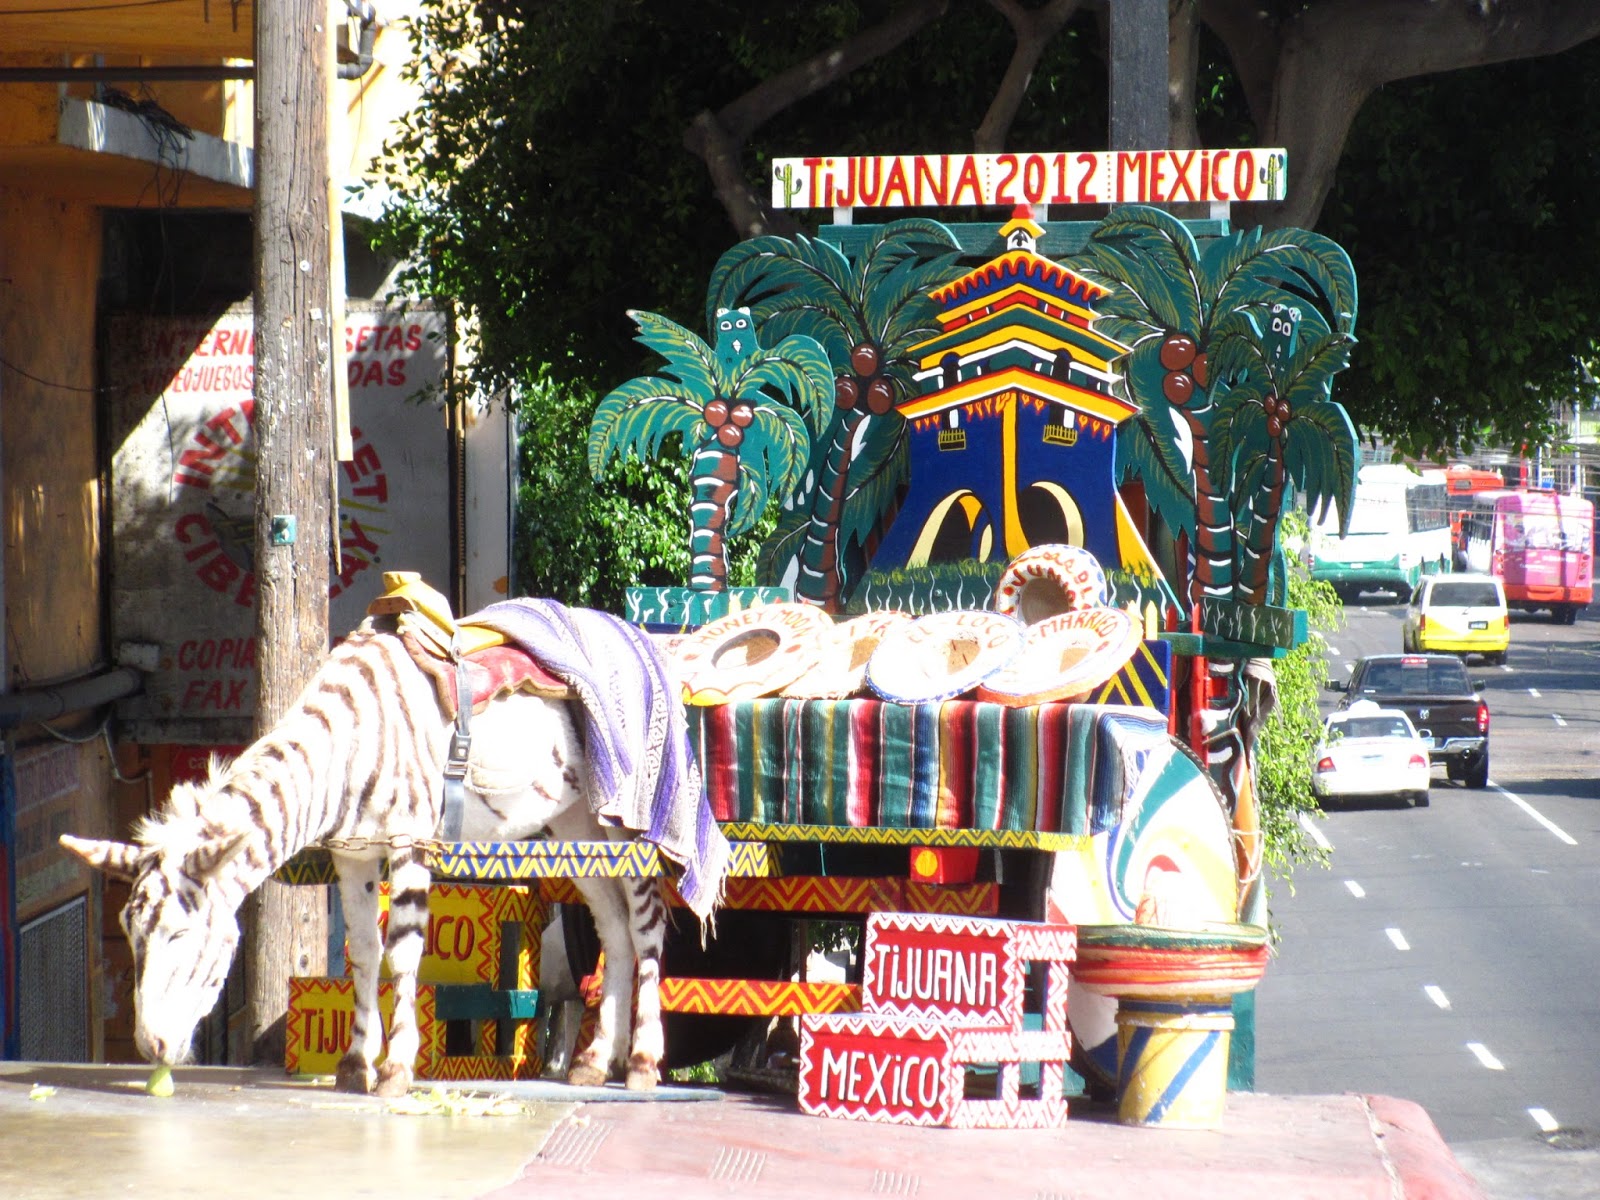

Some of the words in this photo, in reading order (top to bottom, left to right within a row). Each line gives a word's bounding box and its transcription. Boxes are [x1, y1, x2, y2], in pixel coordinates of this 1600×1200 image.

[995, 152, 1098, 205] 2012
[697, 611, 768, 645] HONEY
[771, 609, 815, 640] MOON
[182, 679, 248, 710] FAX
